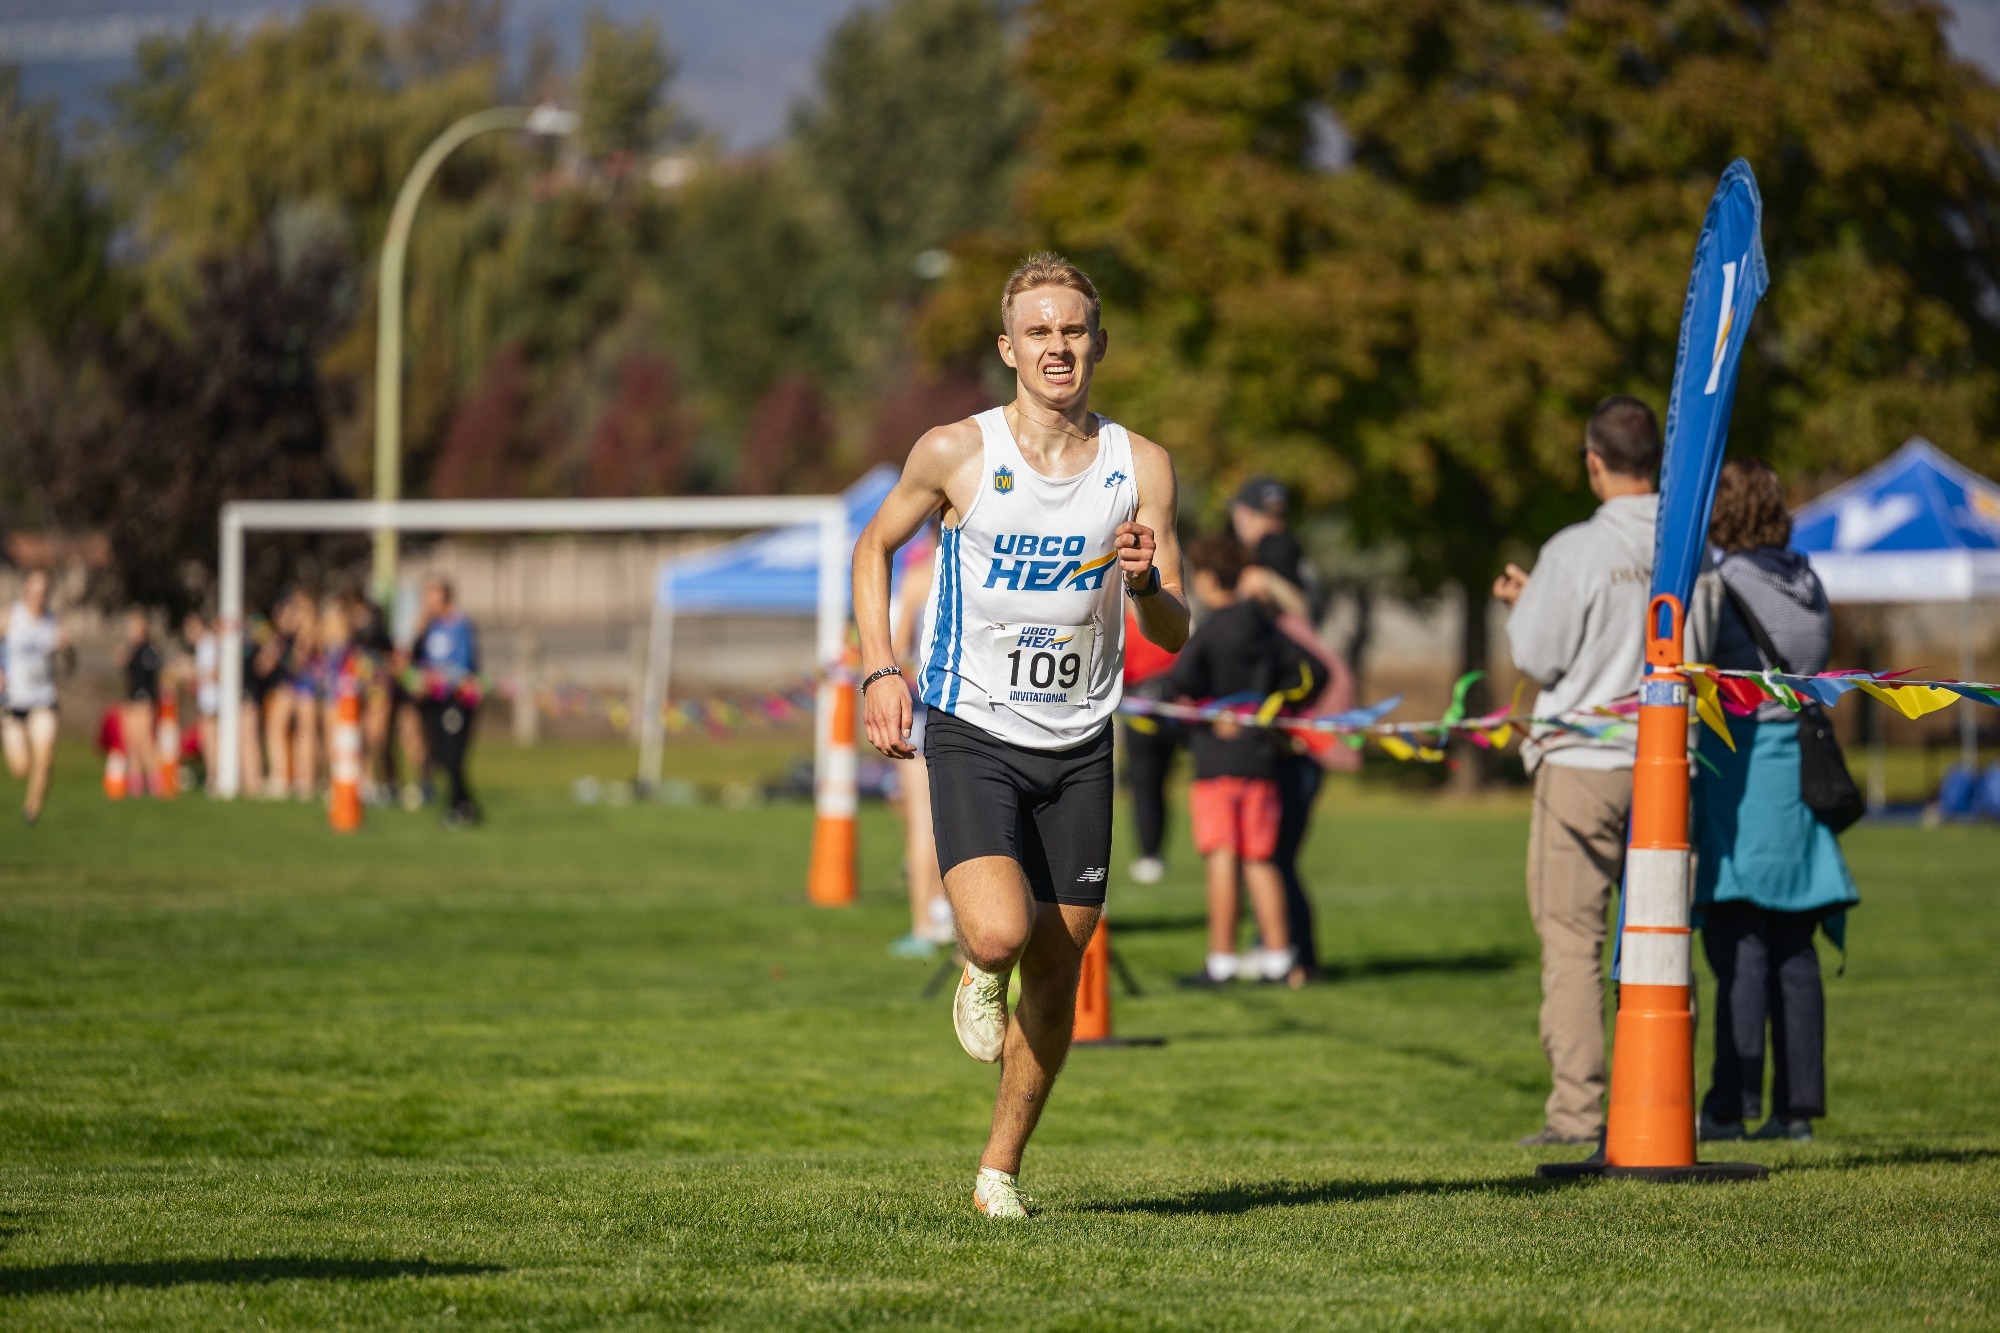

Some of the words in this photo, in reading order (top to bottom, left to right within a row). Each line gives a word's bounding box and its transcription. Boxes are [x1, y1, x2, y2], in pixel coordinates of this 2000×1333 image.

[993, 534, 1087, 557] UBCO
[982, 553, 1118, 592] HEAT
[1021, 626, 1057, 636] UBCO
[1016, 635, 1074, 650] HEAT
[1007, 649, 1081, 689] 109
[1009, 690, 1068, 703] INVITATIONAL
